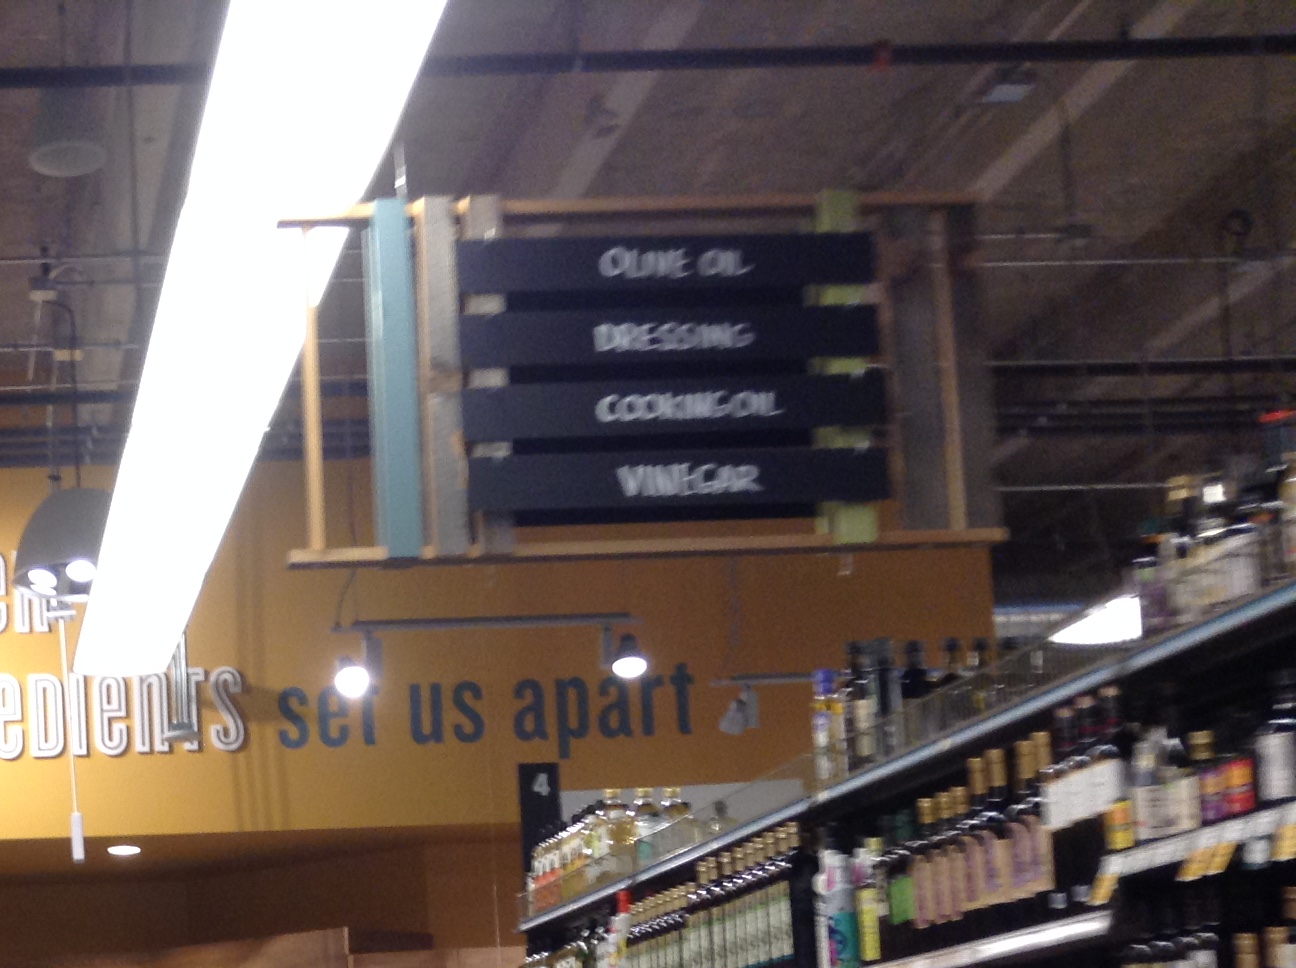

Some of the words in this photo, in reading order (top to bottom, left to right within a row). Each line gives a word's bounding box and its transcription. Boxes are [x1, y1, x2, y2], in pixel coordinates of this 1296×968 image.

[697, 249, 755, 277] OIL
[593, 322, 755, 352] DRESSING
[595, 390, 729, 422] COOKING
[729, 390, 785, 418] OIL
[616, 462, 765, 497] VINEGAR
[278, 684, 380, 750] set
[408, 682, 486, 746] us
[513, 662, 695, 760] apart
[532, 772, 551, 797] 4
